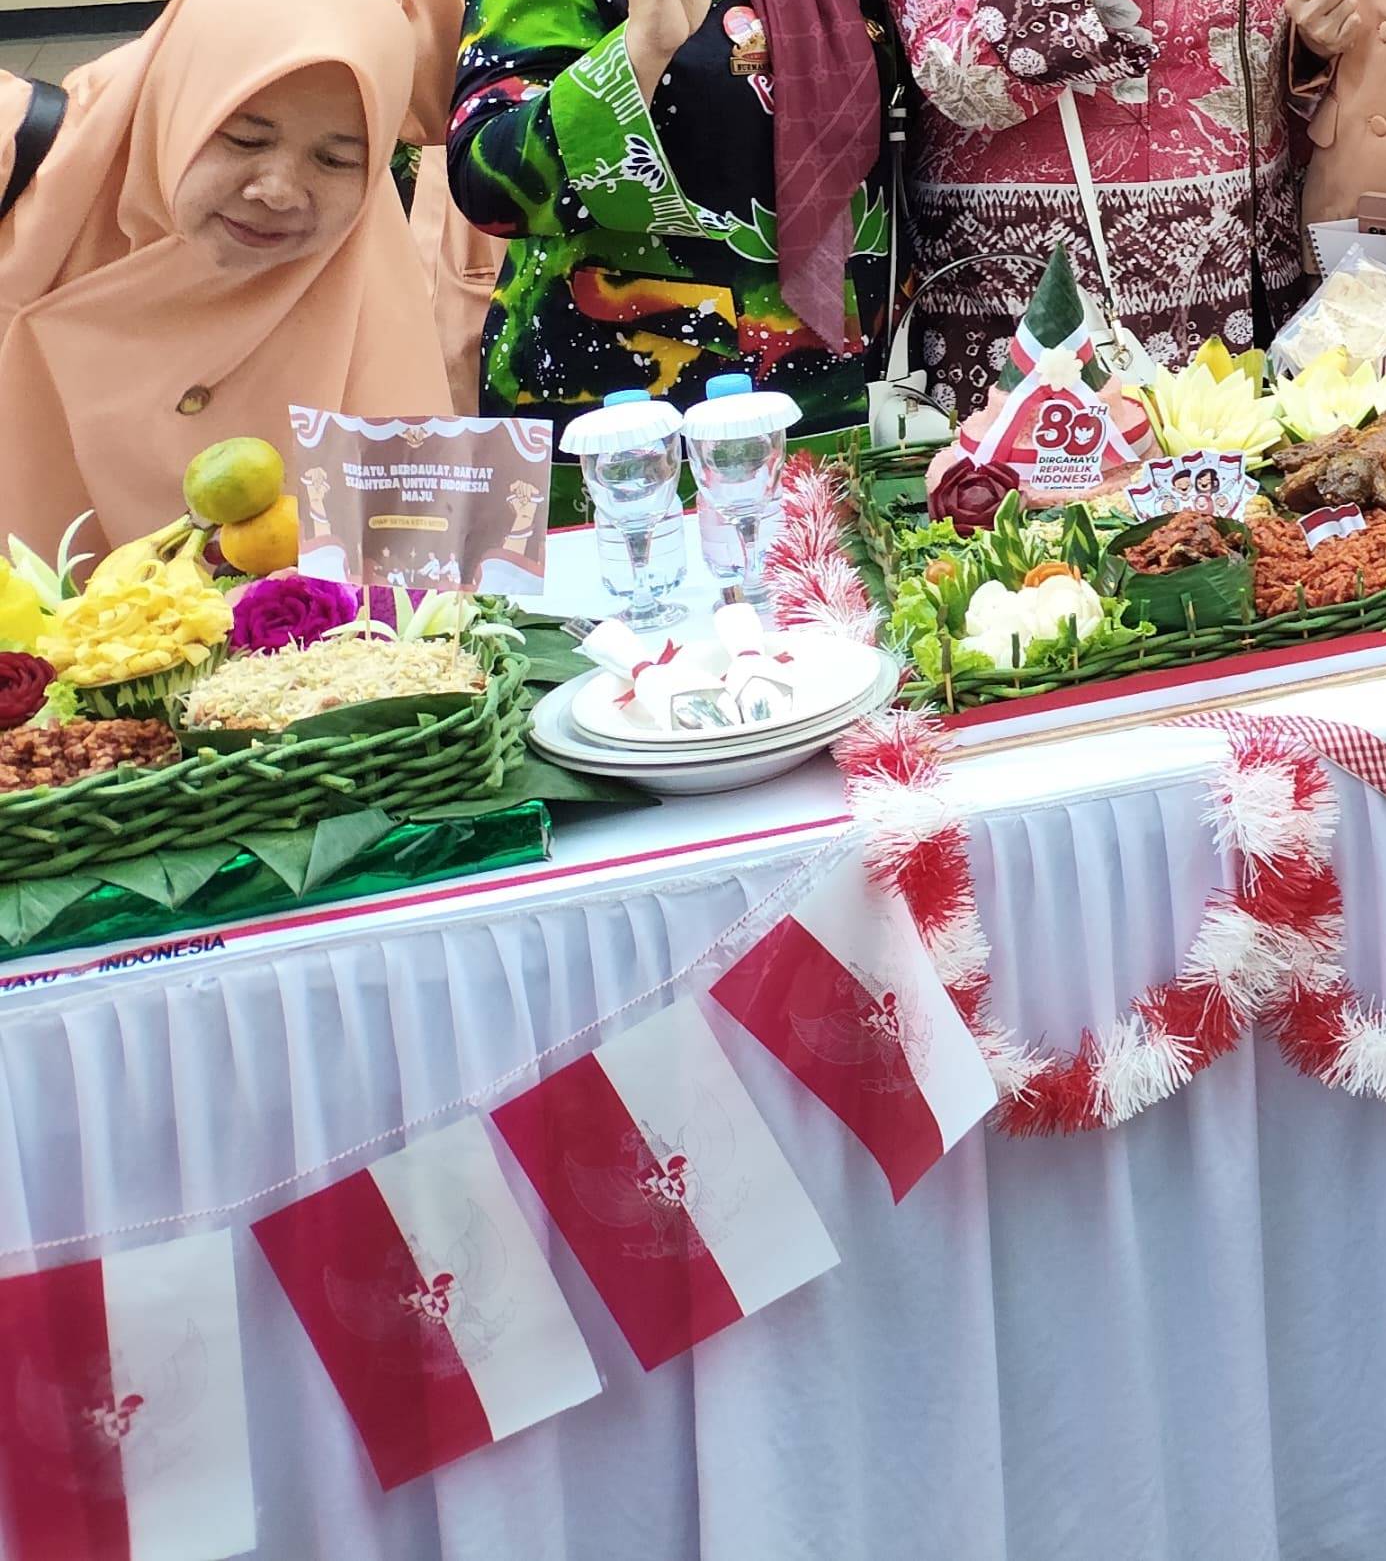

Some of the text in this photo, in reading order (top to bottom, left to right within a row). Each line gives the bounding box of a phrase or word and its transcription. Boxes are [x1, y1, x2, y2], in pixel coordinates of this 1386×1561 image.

[1038, 456, 1099, 464] DIRGAHAYU
[1039, 465, 1093, 474] REPUBLIK
[402, 476, 439, 490] UNTUK
[1031, 474, 1102, 484] INDONESIA
[98, 933, 226, 973] INDONESIA
